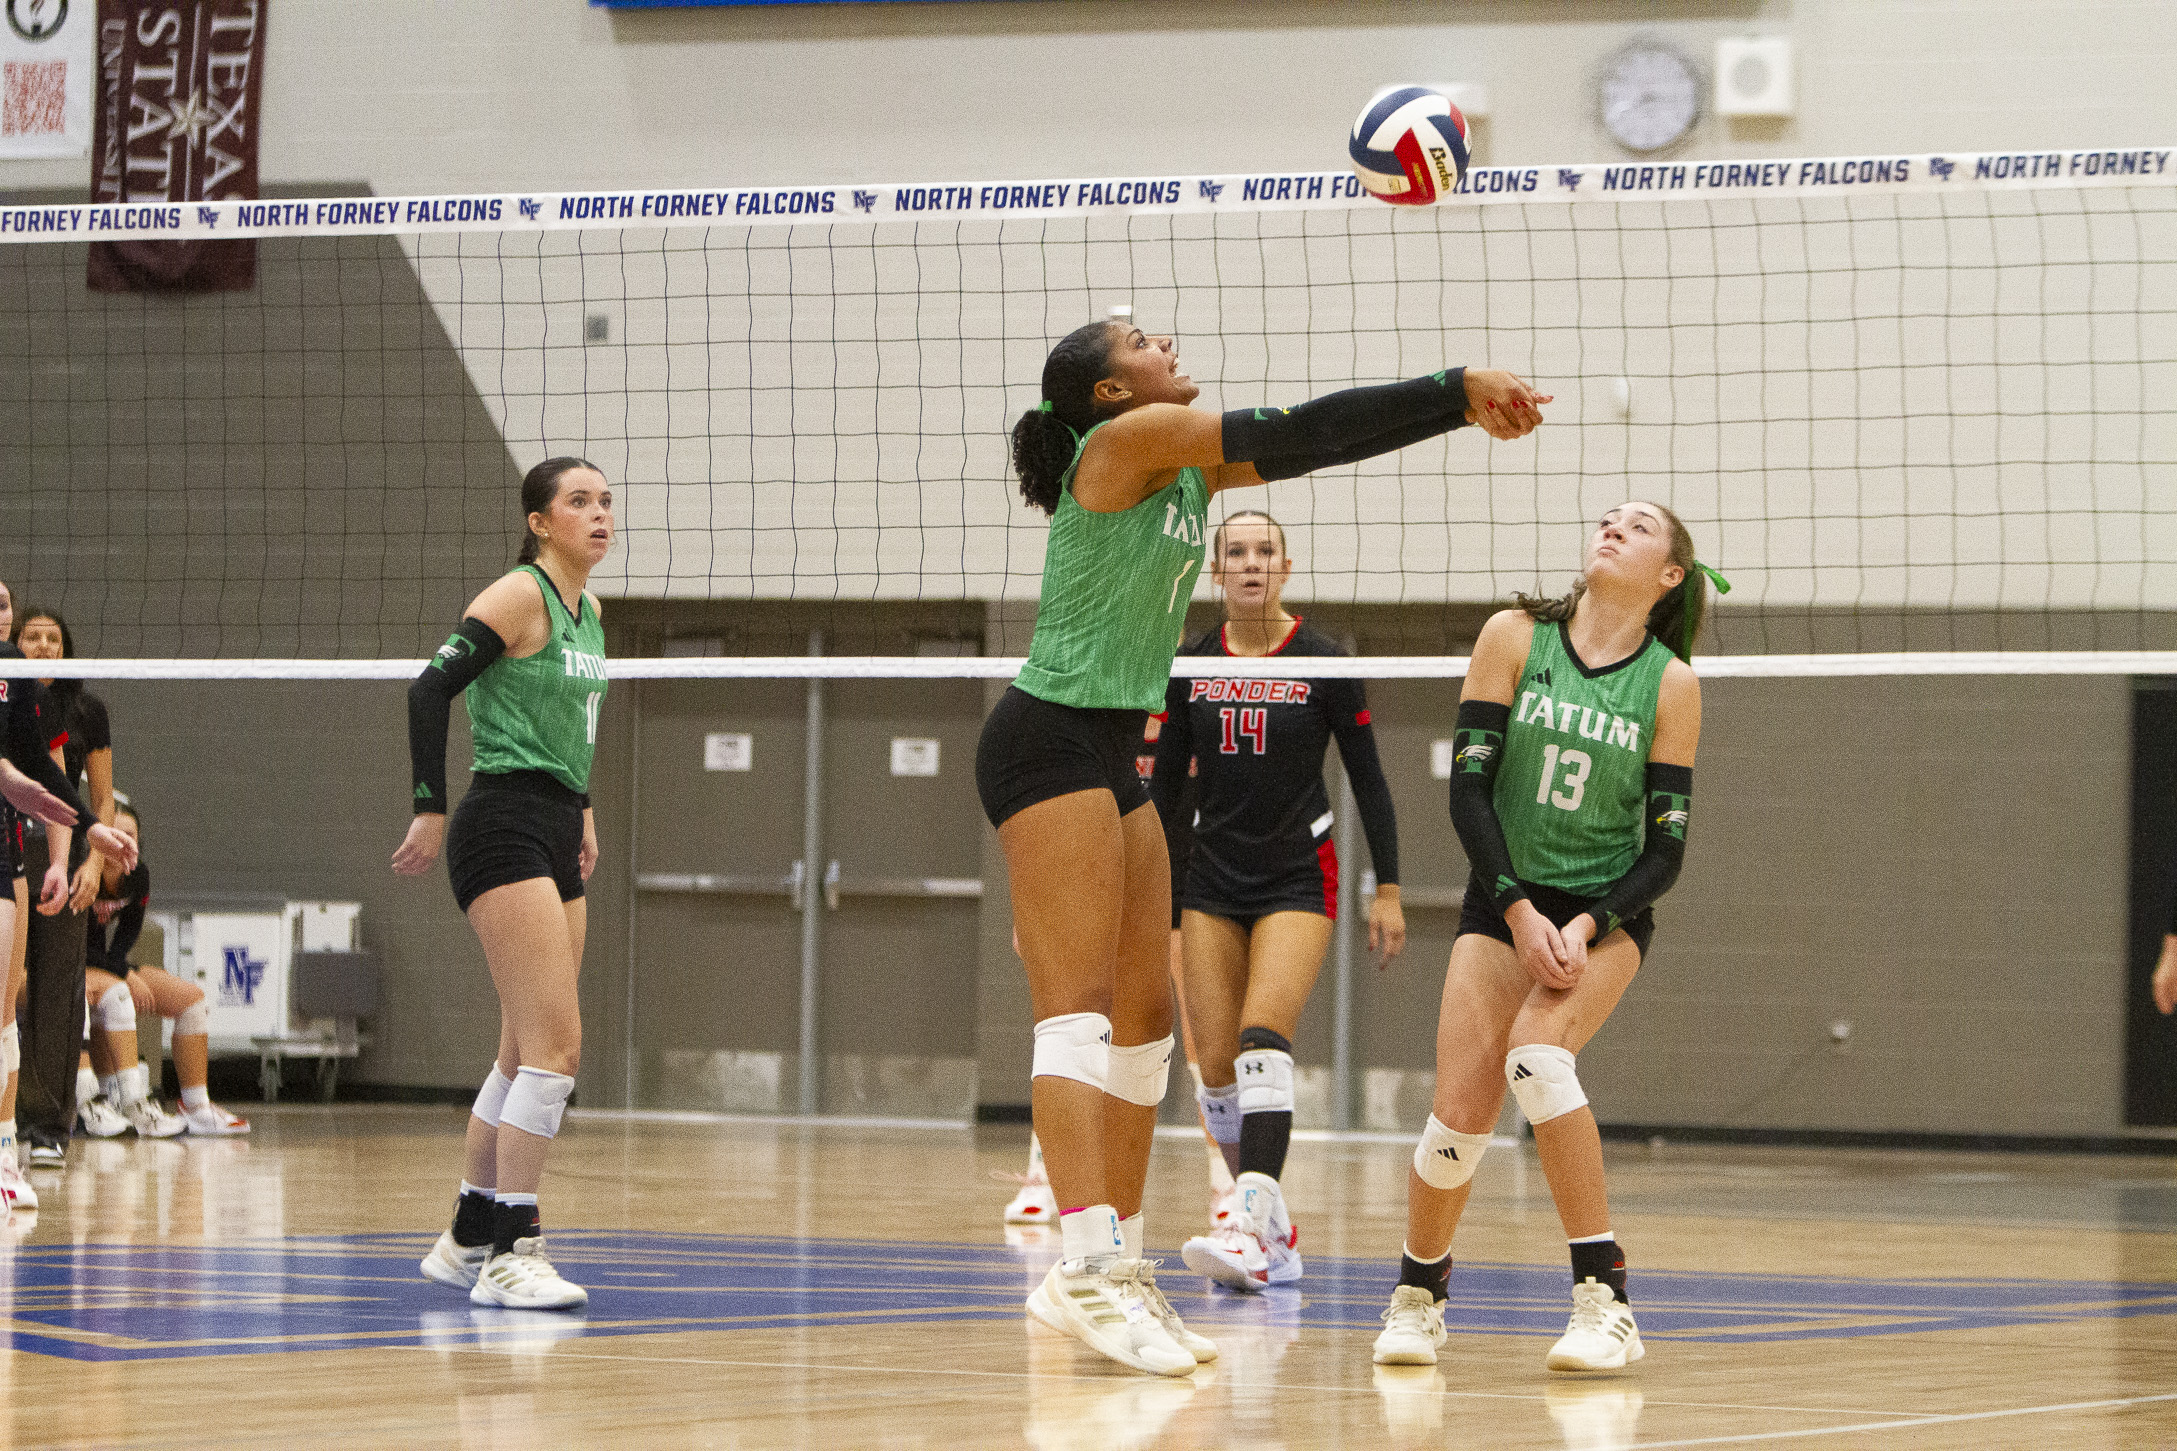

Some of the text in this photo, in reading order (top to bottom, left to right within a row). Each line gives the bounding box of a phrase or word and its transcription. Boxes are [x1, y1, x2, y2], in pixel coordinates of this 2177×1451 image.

[202, 0, 258, 202] TEXA
[1, 209, 82, 233] FORNEY
[88, 207, 181, 231] FALCONS
[237, 203, 309, 228] NORTH
[316, 201, 400, 226] FORNEY
[406, 198, 503, 223] FALCONS
[519, 198, 543, 221] NF
[559, 196, 635, 220] NORTH
[641, 193, 730, 218] FORNEY
[735, 191, 836, 216] FALCONS
[852, 189, 878, 213] NF
[895, 187, 973, 212] NORTH
[980, 184, 1071, 209] FORNEY
[1077, 181, 1181, 207] FALCONS
[1198, 180, 1225, 203] NF
[1242, 176, 1324, 201] NORTH
[1453, 170, 1539, 194] LCONS
[1603, 166, 1686, 191] NORTH
[1694, 162, 1791, 188] FORNEY
[1799, 159, 1910, 186] FALCONS
[1974, 154, 2061, 179] NORTH
[2069, 151, 2170, 176] FORNEY
[1429, 148, 1453, 191] Baden
[561, 648, 606, 681] TATU
[1189, 678, 1312, 704] PONDER
[586, 691, 601, 745] 11
[1219, 707, 1267, 754] 14
[1516, 691, 1640, 753] TATUM
[1536, 744, 1592, 812] 13
[222, 944, 269, 1005] NF
